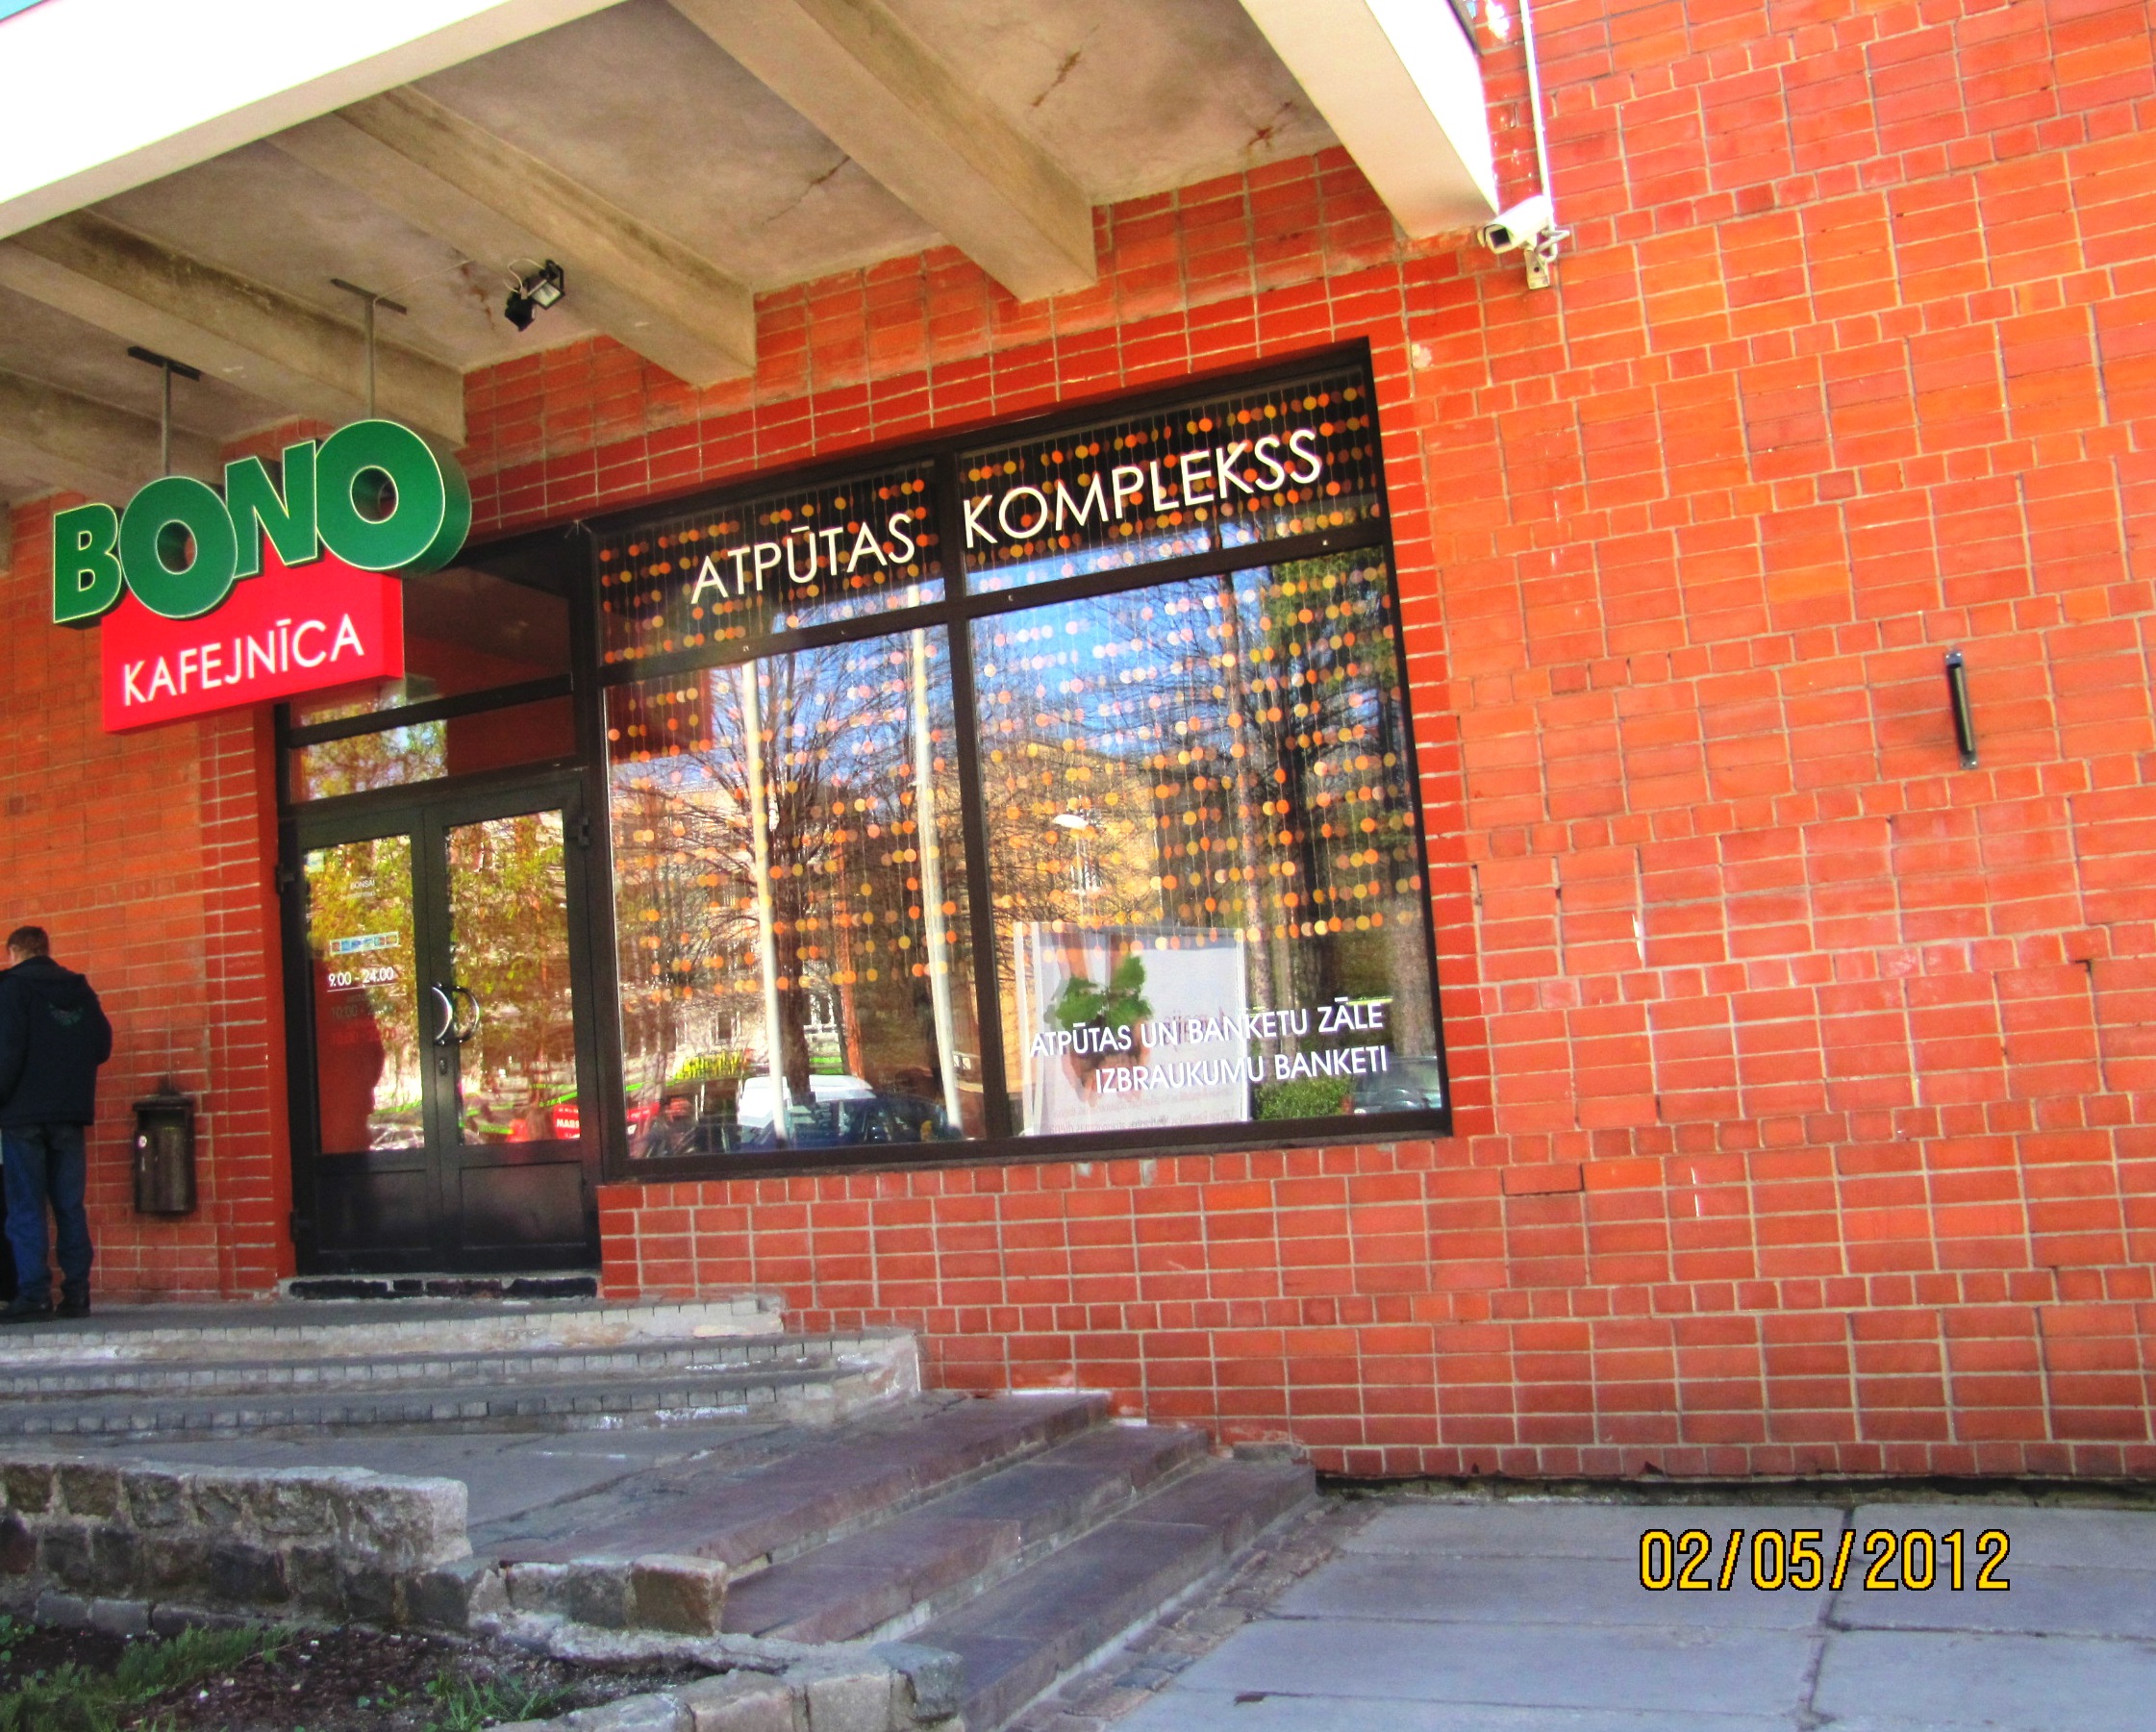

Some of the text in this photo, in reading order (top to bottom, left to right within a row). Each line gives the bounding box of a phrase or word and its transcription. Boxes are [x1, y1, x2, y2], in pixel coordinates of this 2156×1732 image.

[53, 418, 470, 626] BONO
[690, 429, 1321, 604] ATPŪTAS KOMPLEKSS
[123, 613, 364, 706] KAFEJNĪCA
[328, 970, 352, 988] 9.00
[362, 966, 394, 984] 24.00
[1030, 1022, 1131, 1058] ATPŪTAS
[1141, 1020, 1179, 1049] UN
[1189, 1010, 1309, 1044] BANKETU
[1317, 996, 1384, 1033] ZĀLE
[1095, 1045, 1388, 1094] IZBRAUKUMU BANKETI
